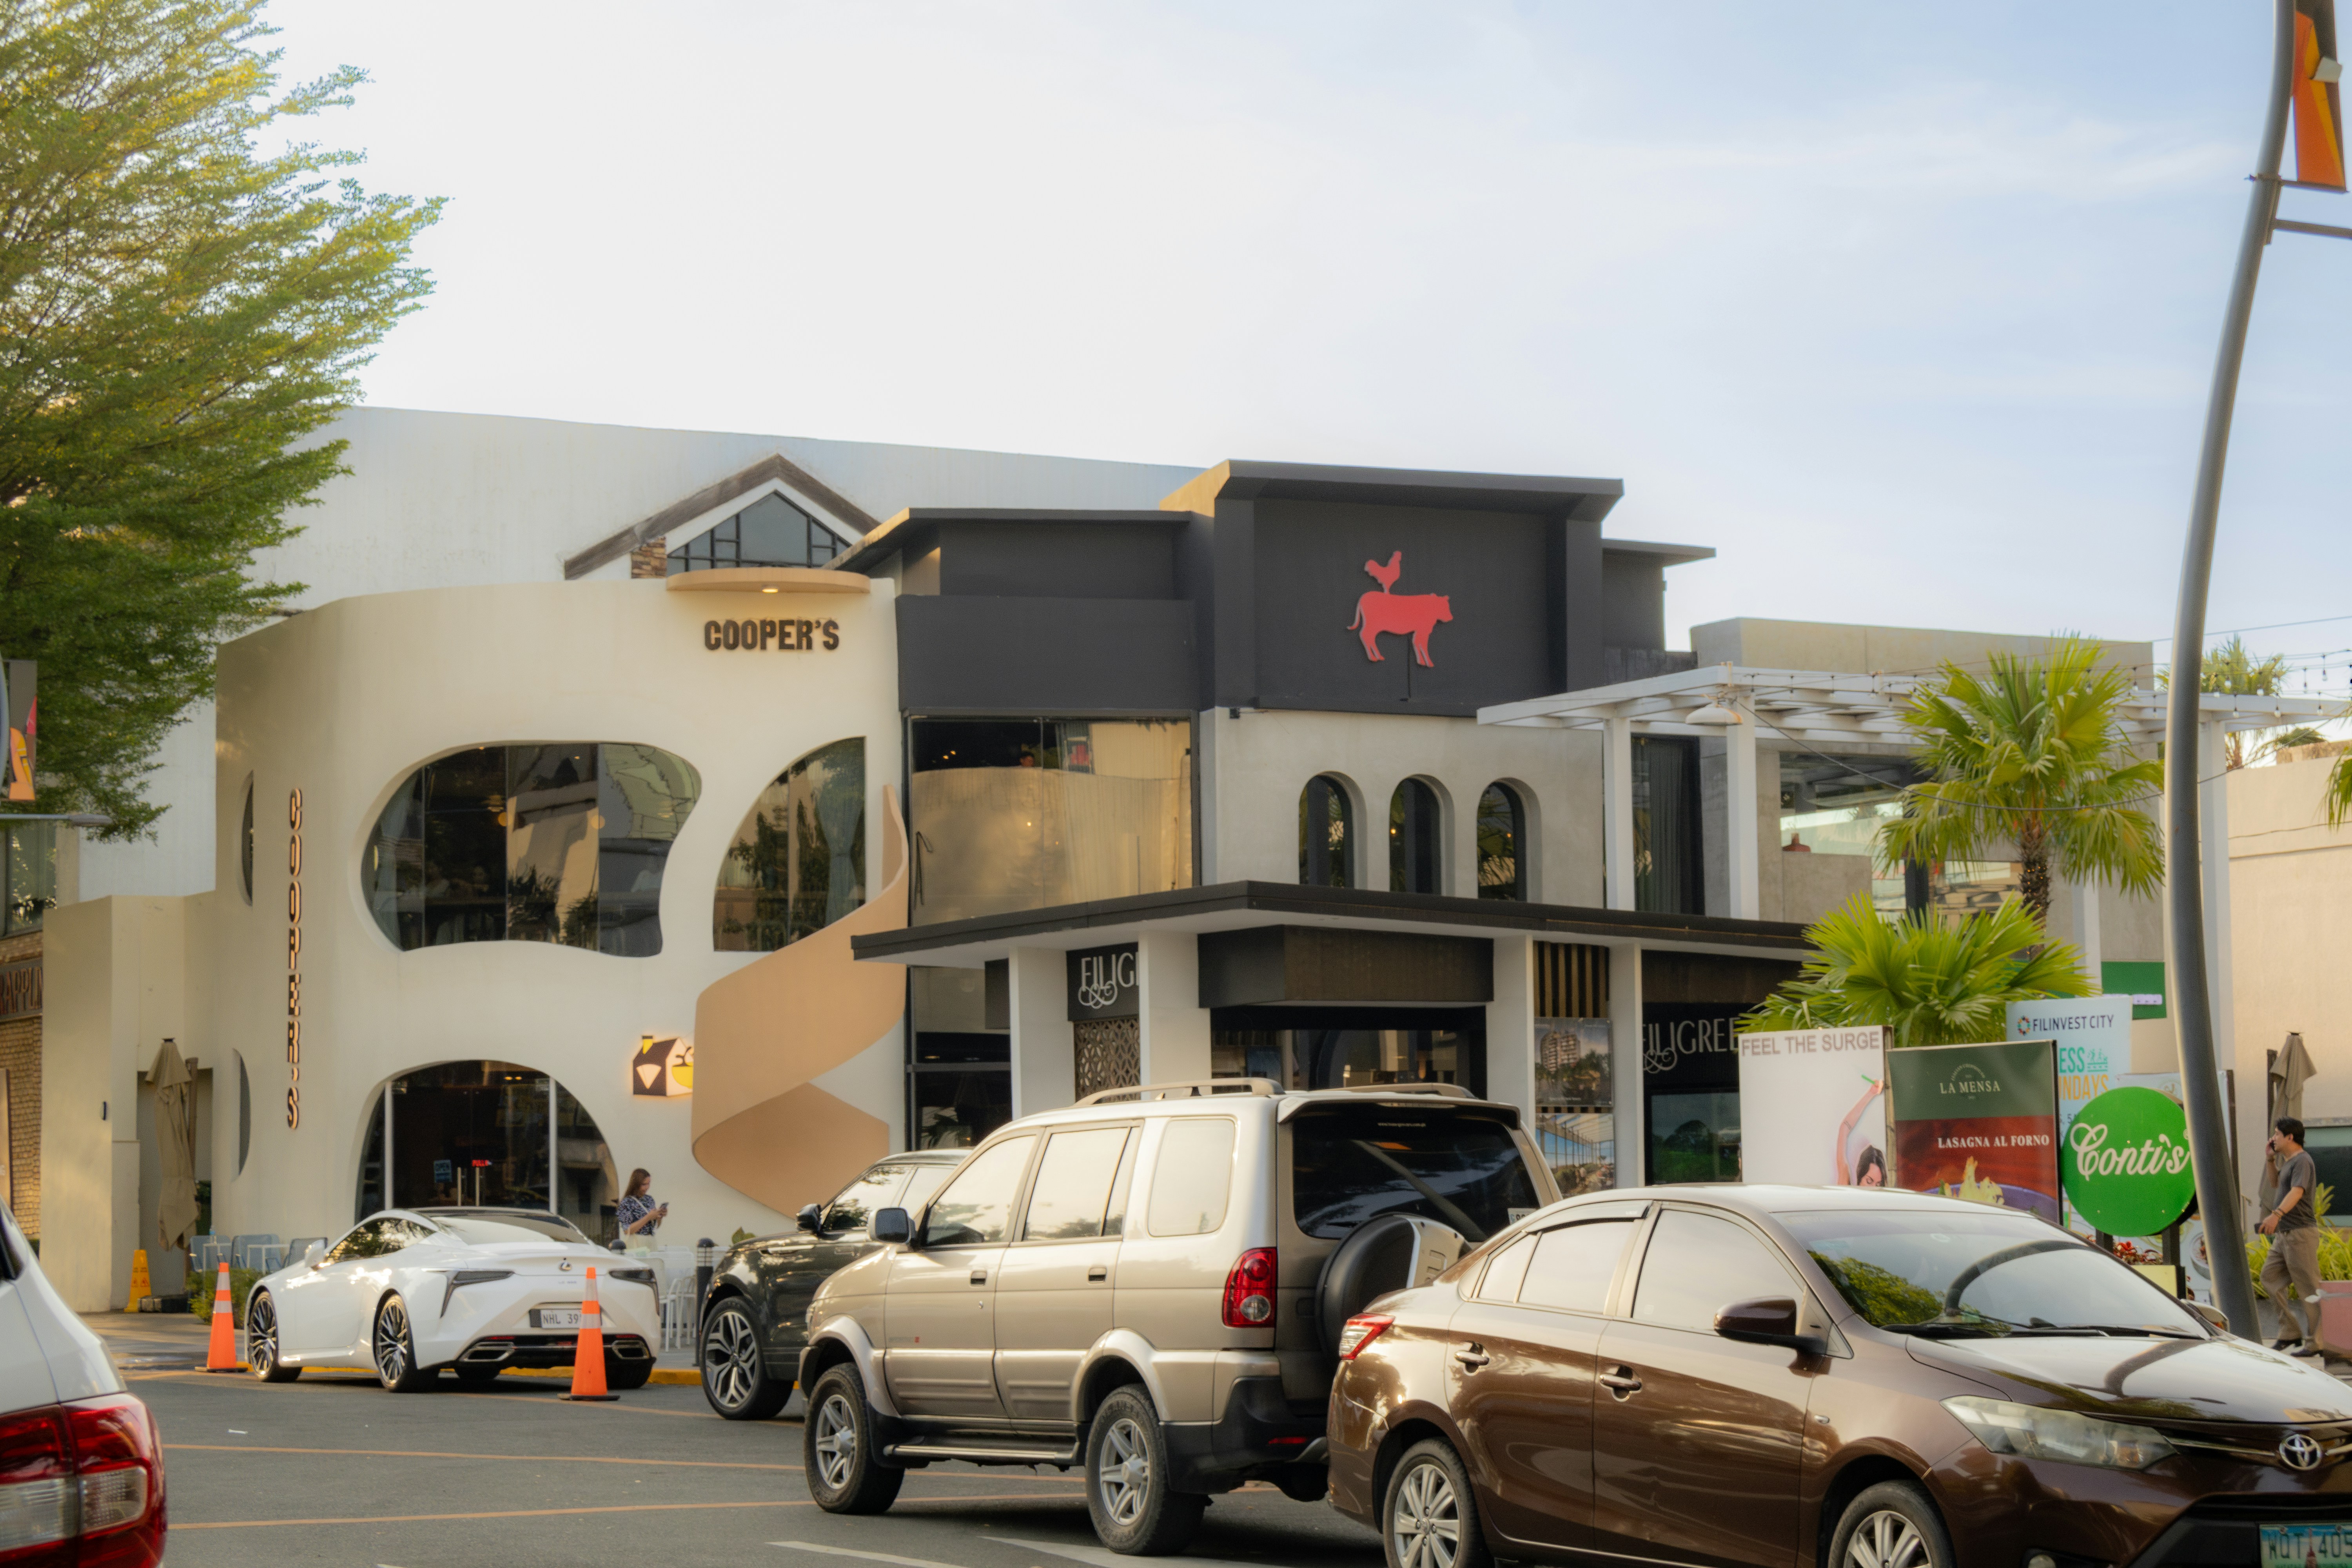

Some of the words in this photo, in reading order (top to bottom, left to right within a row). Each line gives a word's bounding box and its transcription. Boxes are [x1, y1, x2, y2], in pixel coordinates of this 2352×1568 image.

[704, 619, 839, 651] COOPER'S
[287, 788, 302, 1129] COOPER'S
[2033, 1016, 2087, 1032] FILINVEST
[2090, 1014, 2114, 1029] CITY
[1742, 1037, 1780, 1056] FEEL
[1784, 1034, 1817, 1054] THE
[1822, 1031, 1880, 1051] SURGE
[1940, 1082, 1956, 1094] LA
[1960, 1080, 2001, 1093] MENSA
[1937, 1137, 1990, 1149] LASAGNA
[1993, 1136, 2008, 1147] AL
[2011, 1134, 2050, 1147] FORNO
[2070, 1123, 2190, 1181] Conti's
[543, 1314, 561, 1324] NHL
